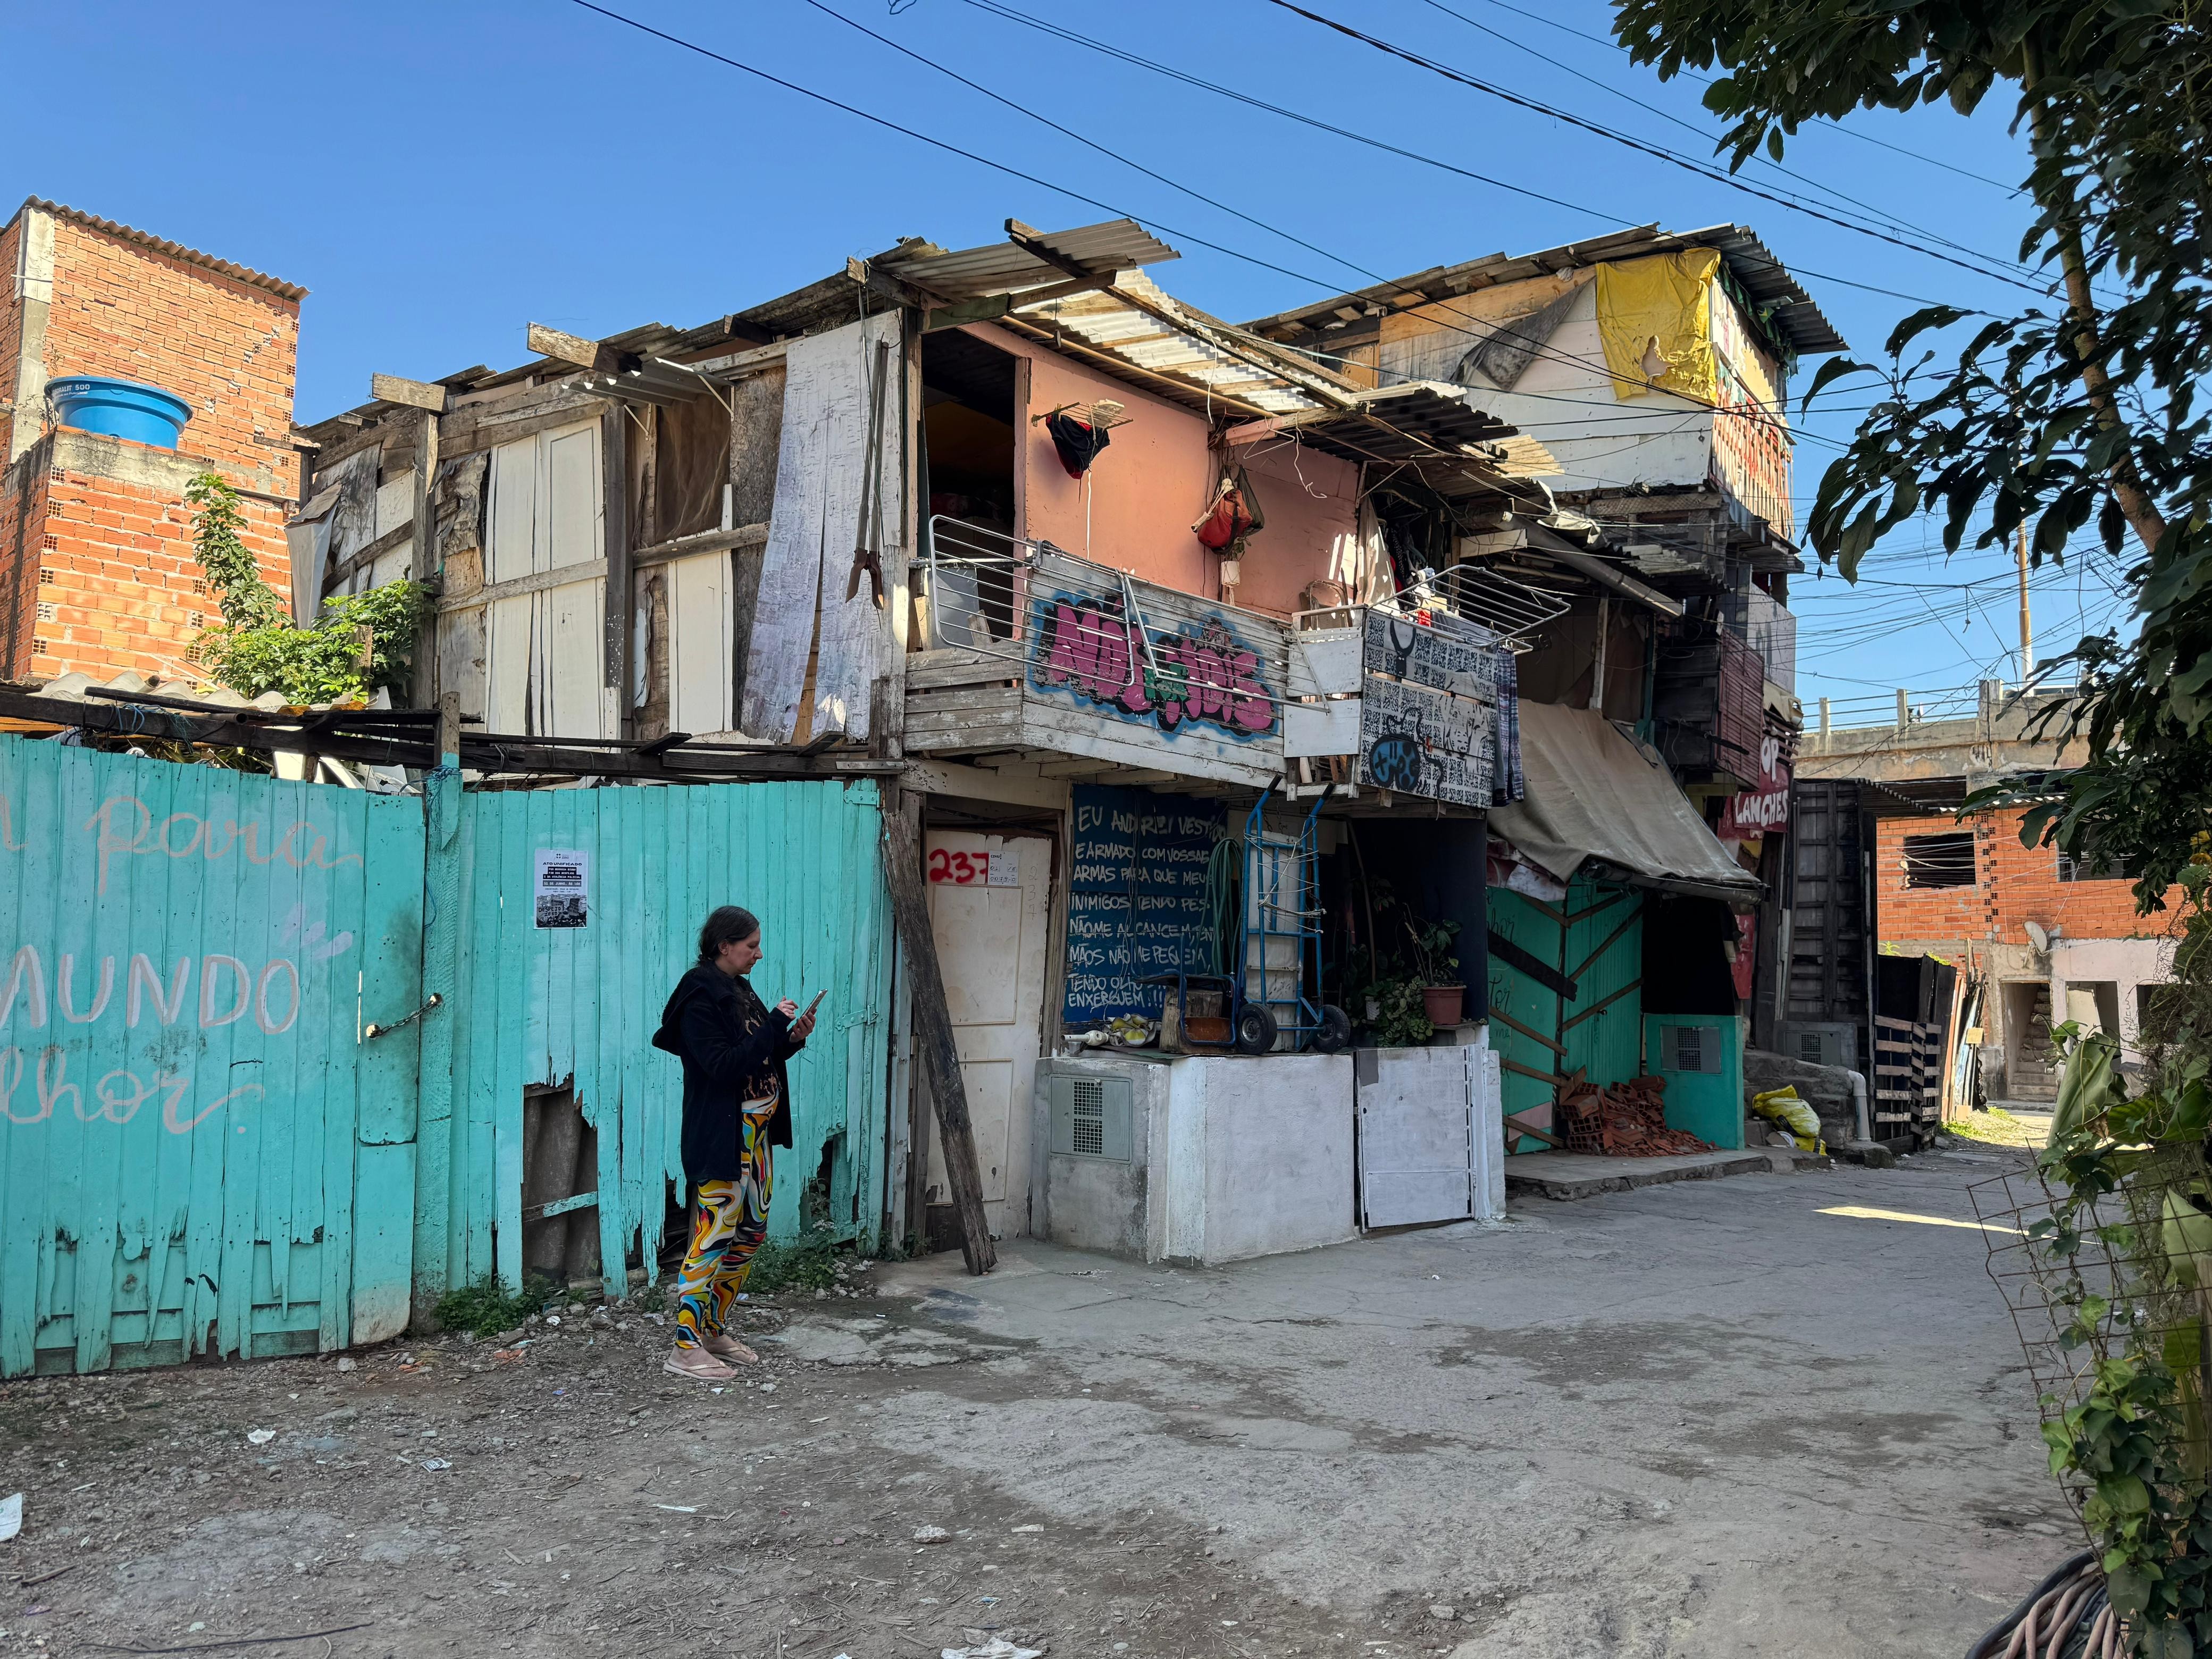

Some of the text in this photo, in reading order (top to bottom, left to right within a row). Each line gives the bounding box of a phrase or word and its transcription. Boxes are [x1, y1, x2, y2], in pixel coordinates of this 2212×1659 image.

[1078, 806, 1103, 832] EU
[1735, 790, 1788, 827] LANCHES
[1075, 841, 1210, 864] E ARMADO COM VOSSAS
[1073, 865, 1116, 883] ARMAS
[1121, 867, 1151, 884] PARA
[1154, 868, 1178, 884] QUE
[1137, 895, 1176, 911] TENDO
[1094, 921, 1113, 939] ME
[1069, 942, 1105, 968] MÃOS
[1109, 945, 1130, 965] NÃO
[1068, 973, 1154, 992] TENDO OLHO
